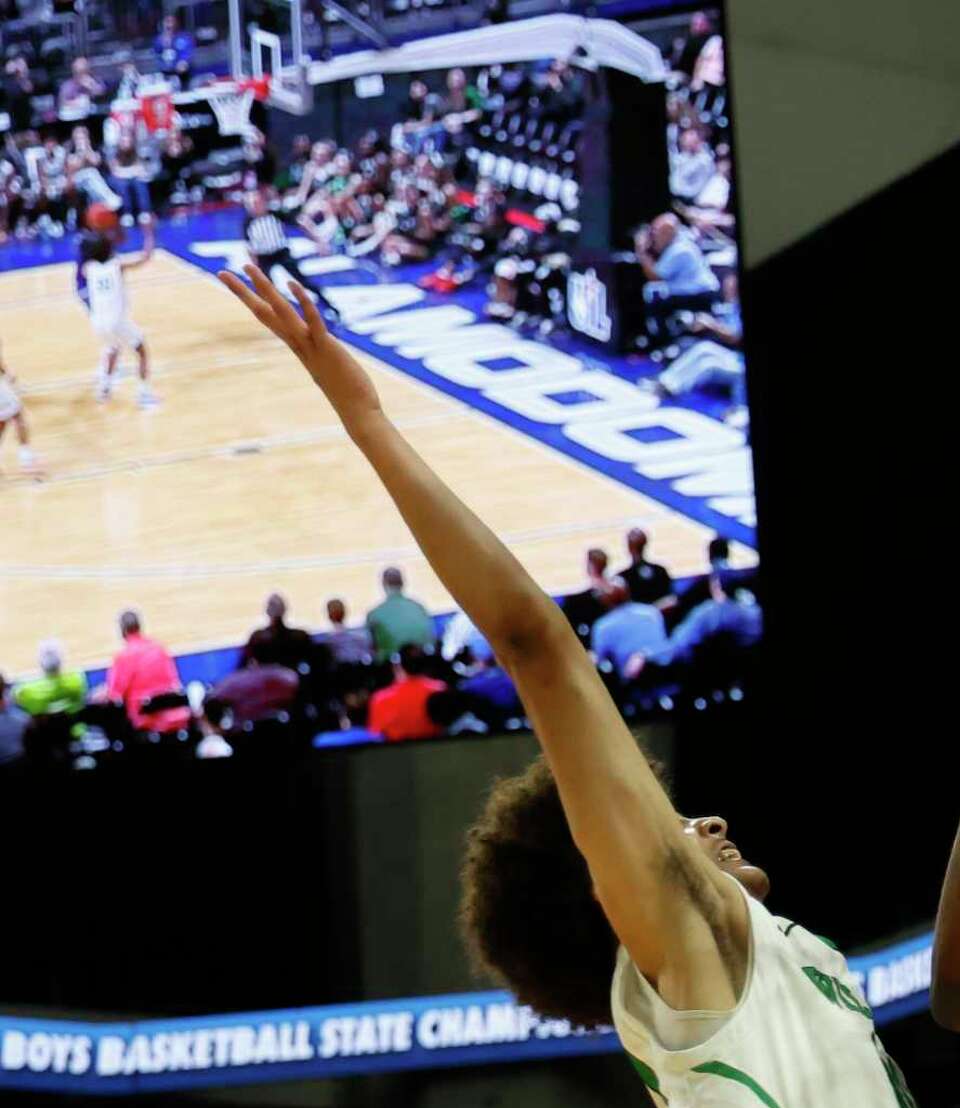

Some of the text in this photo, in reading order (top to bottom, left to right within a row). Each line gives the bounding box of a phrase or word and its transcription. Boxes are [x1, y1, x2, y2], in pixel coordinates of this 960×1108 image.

[3, 1028, 93, 1076] BOYS
[96, 1019, 315, 1077] BASKETBALL
[318, 1010, 414, 1060] STATE
